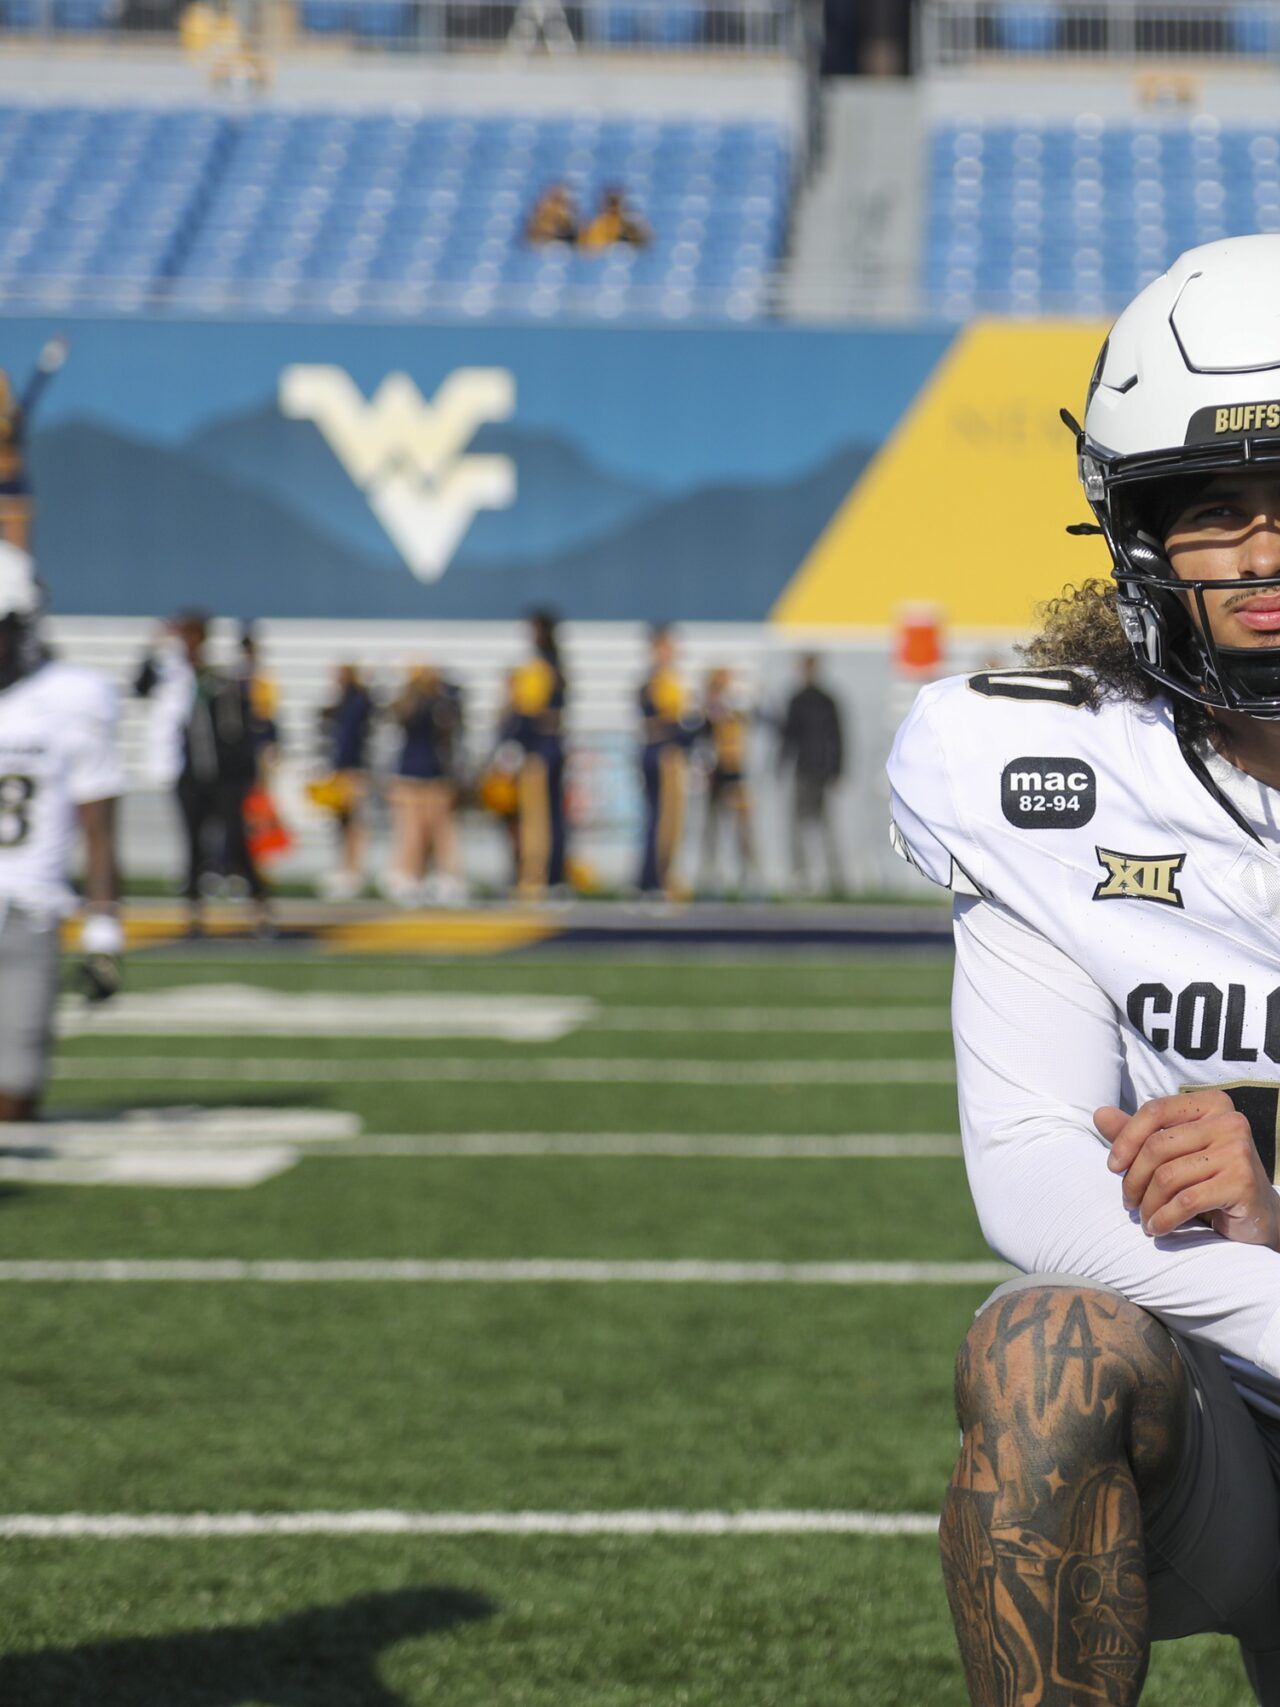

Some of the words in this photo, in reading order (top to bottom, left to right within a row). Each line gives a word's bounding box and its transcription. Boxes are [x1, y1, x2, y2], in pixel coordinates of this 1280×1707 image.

[1215, 403, 1280, 433] BUFFS
[1010, 772, 1089, 791] mac
[1019, 795, 1080, 811] 82-94
[1097, 848, 1185, 905] XII
